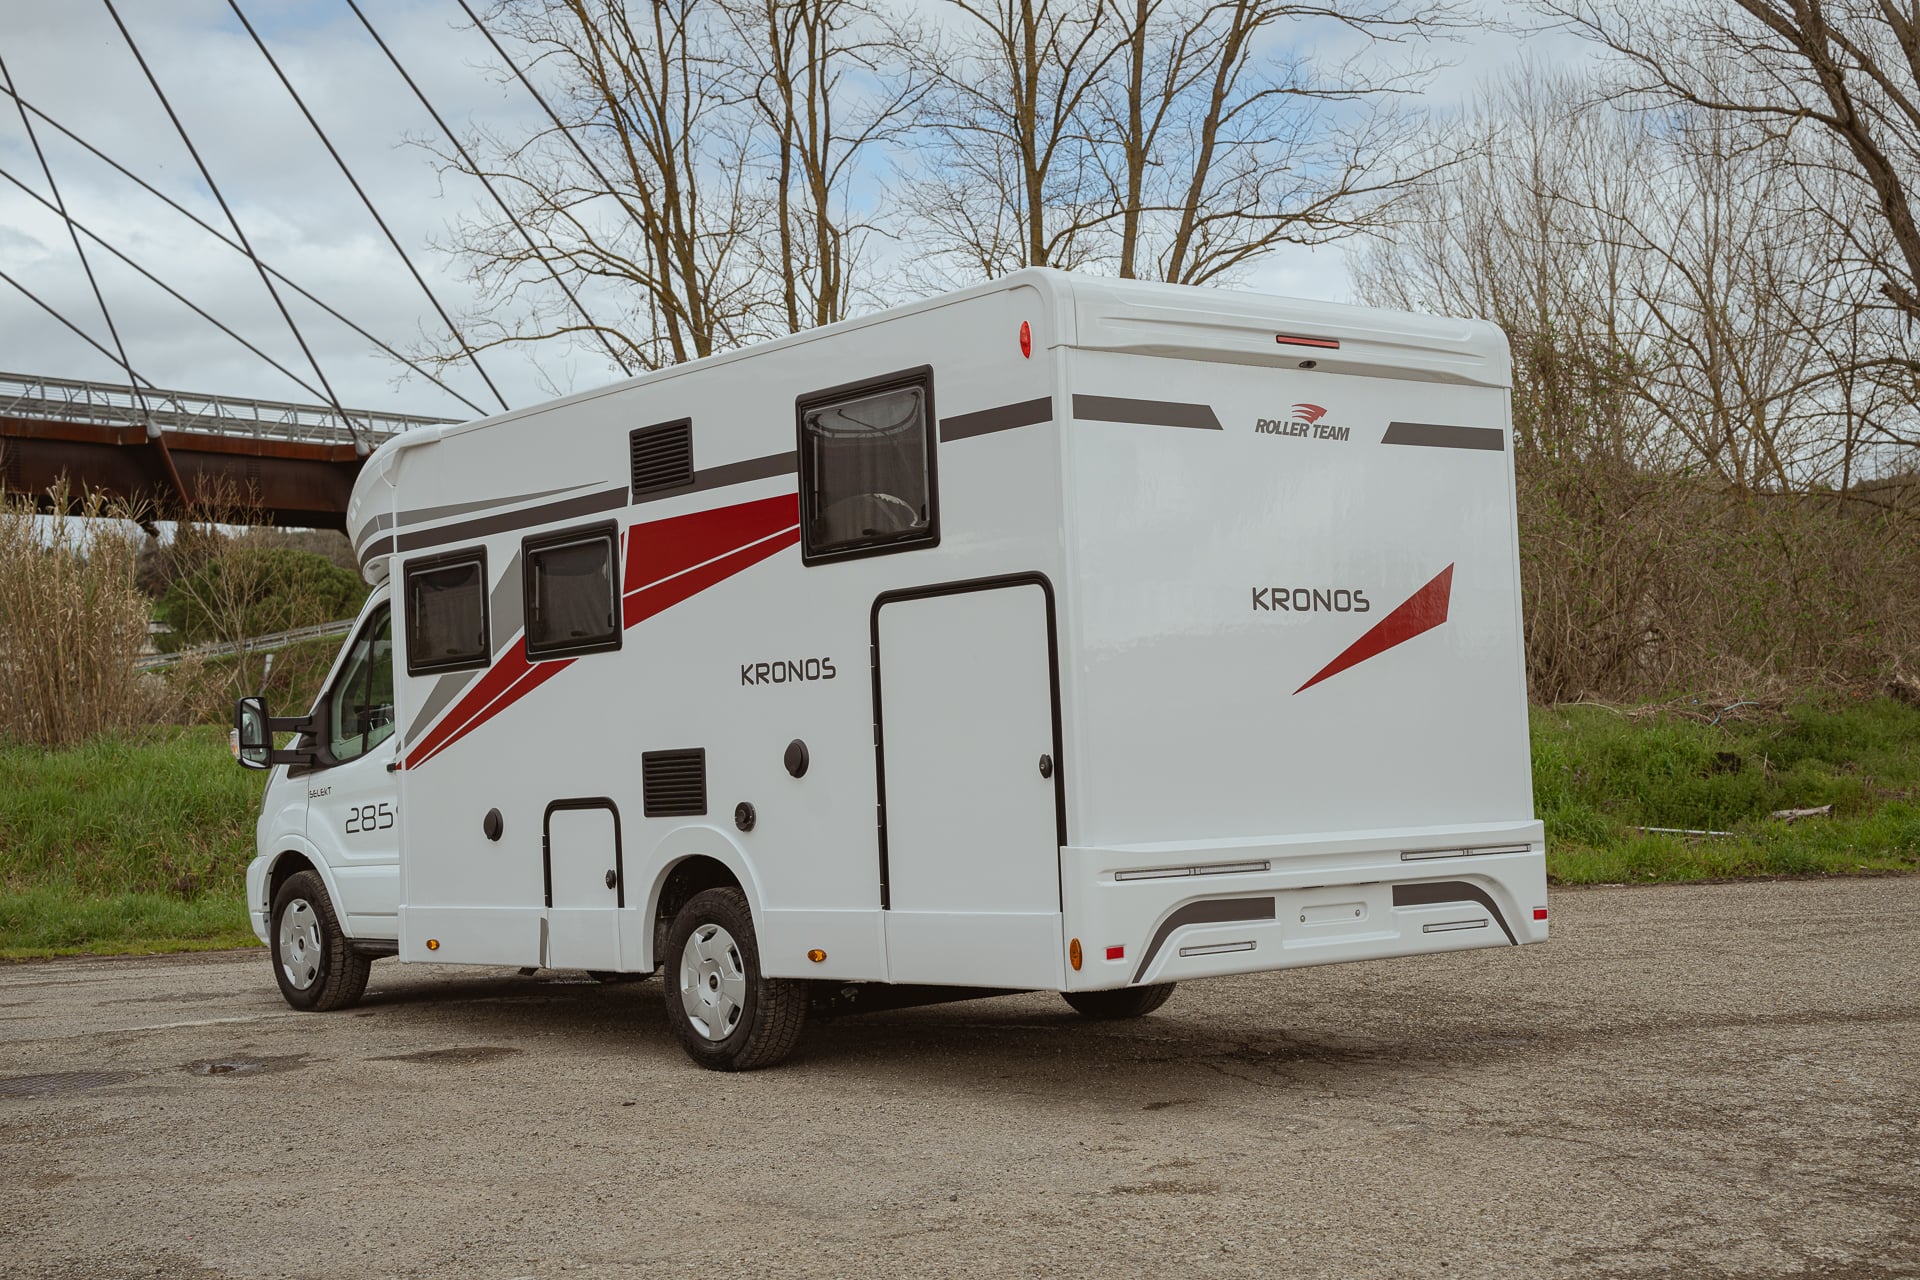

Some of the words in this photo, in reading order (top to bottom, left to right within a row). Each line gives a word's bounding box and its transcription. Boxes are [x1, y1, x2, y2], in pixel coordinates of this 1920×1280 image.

[1255, 418, 1310, 438] ROLLER
[1313, 423, 1351, 442] TEAM
[1252, 587, 1370, 613] KRONOS
[740, 657, 837, 686] KRONOS
[345, 802, 399, 834] 285
